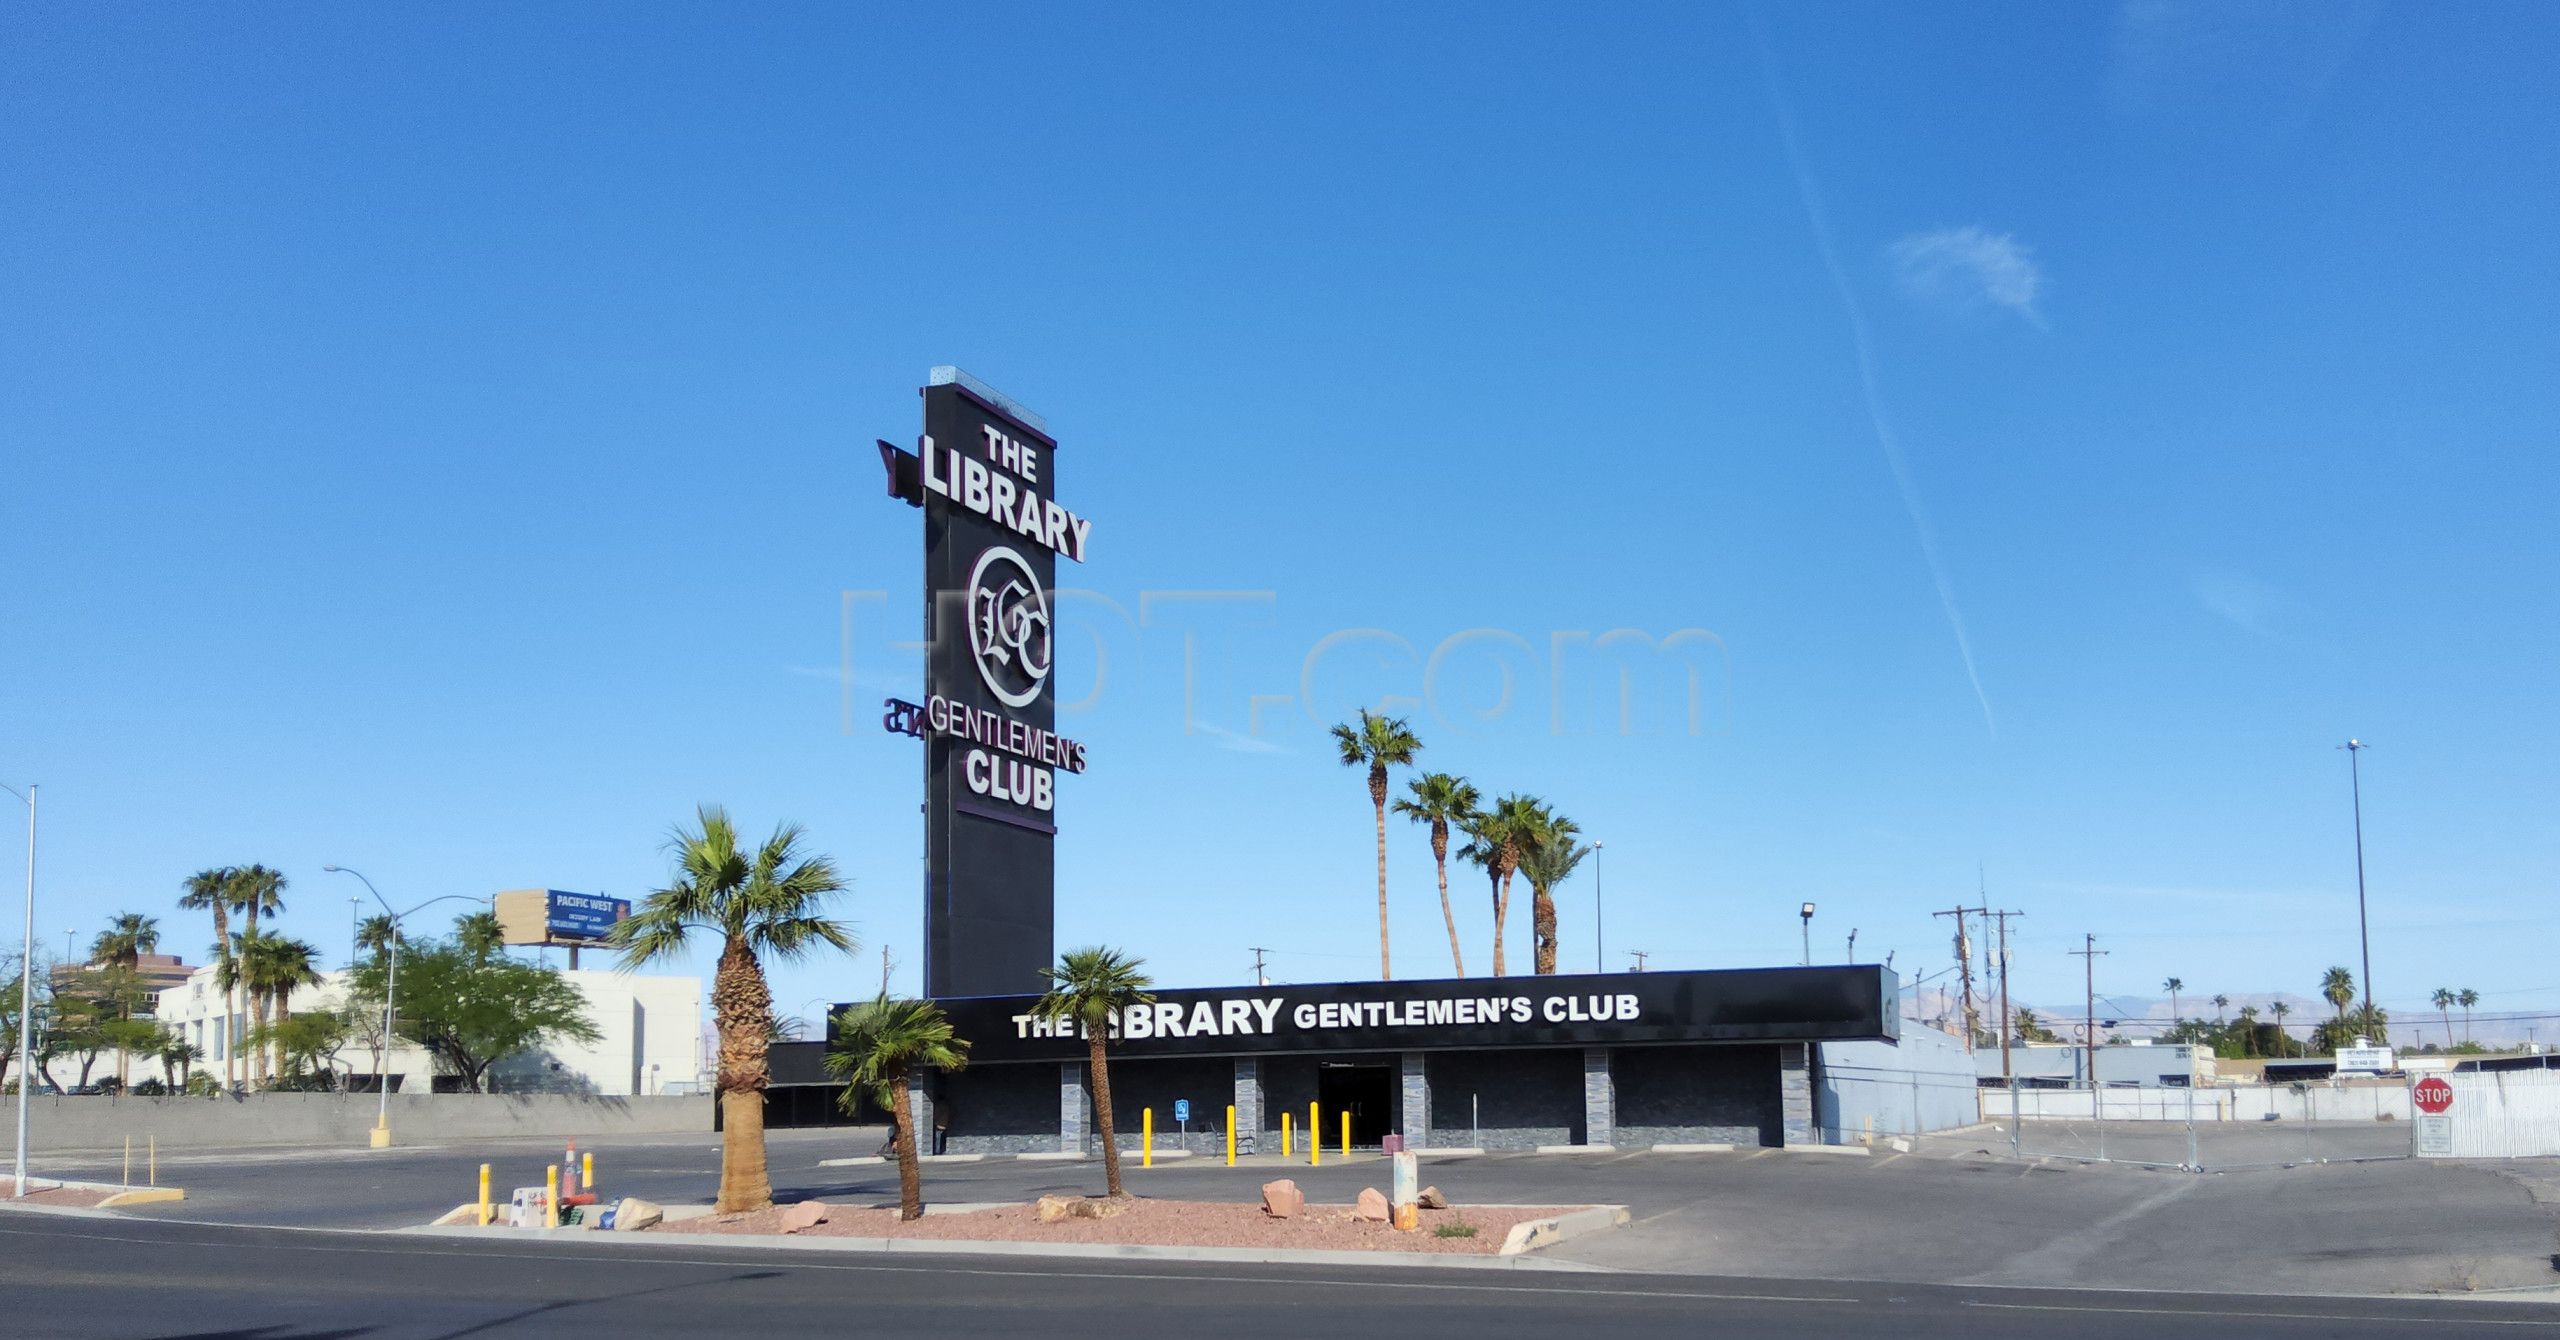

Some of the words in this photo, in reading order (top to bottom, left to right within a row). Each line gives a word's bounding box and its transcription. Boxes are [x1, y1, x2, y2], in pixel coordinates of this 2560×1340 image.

[983, 424, 1037, 484] THE
[922, 434, 1091, 563] LIBRARY
[928, 694, 1088, 774] GENTLEMEN'S
[966, 749, 1053, 811] CLUB
[556, 895, 589, 908] PACIFIC
[590, 899, 614, 912] WEST
[1012, 1013, 1074, 1038] THE
[1080, 998, 1284, 1040] IBRARY
[1293, 997, 1533, 1029] GENTLEMEN'S
[1543, 995, 1640, 1023] CLUB
[2416, 1088, 2451, 1103] STOP
